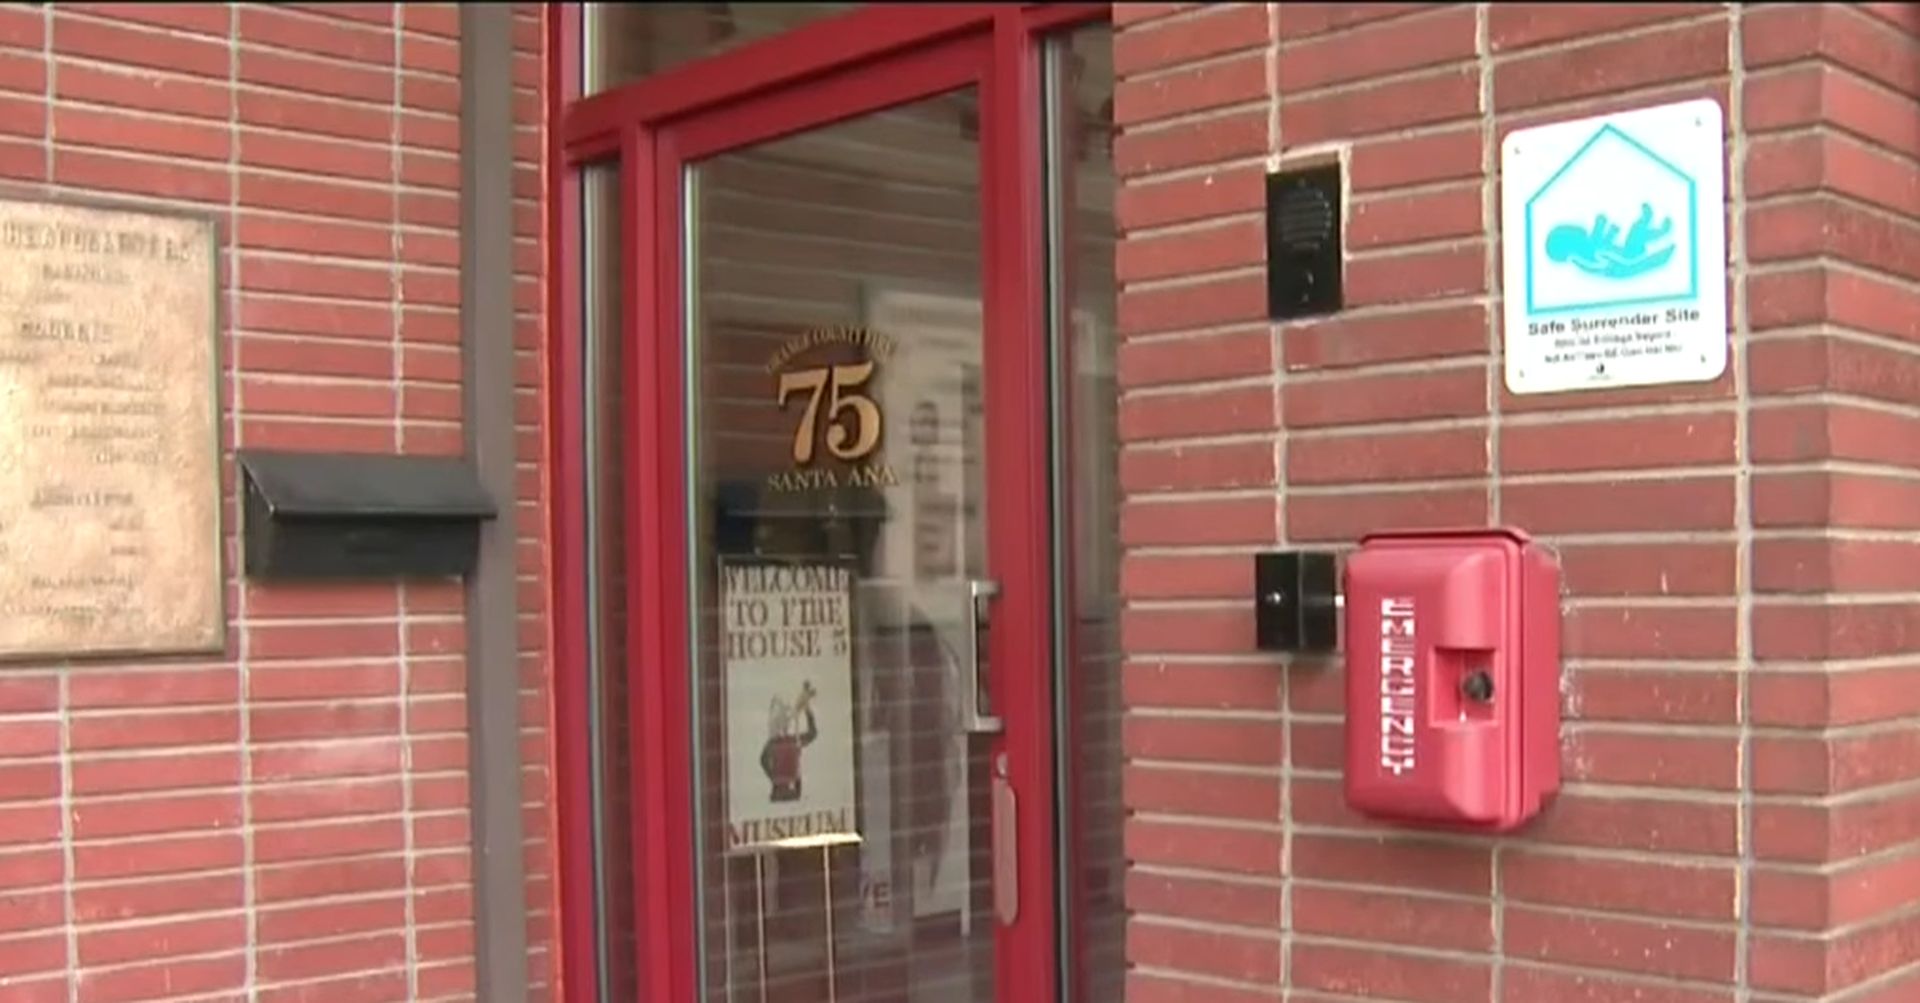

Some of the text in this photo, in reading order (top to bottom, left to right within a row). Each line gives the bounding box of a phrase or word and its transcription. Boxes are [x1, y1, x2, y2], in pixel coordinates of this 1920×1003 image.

[1528, 307, 1700, 336] Safe Surrender Site
[778, 360, 881, 464] 75
[768, 464, 899, 491] SANTA ANA
[723, 566, 850, 594] WELCOME
[730, 596, 844, 627] TO FIRE
[727, 627, 847, 660] HOUSE 5
[1381, 596, 1415, 775] EMERGENCY
[726, 808, 848, 846] MUSEUM
